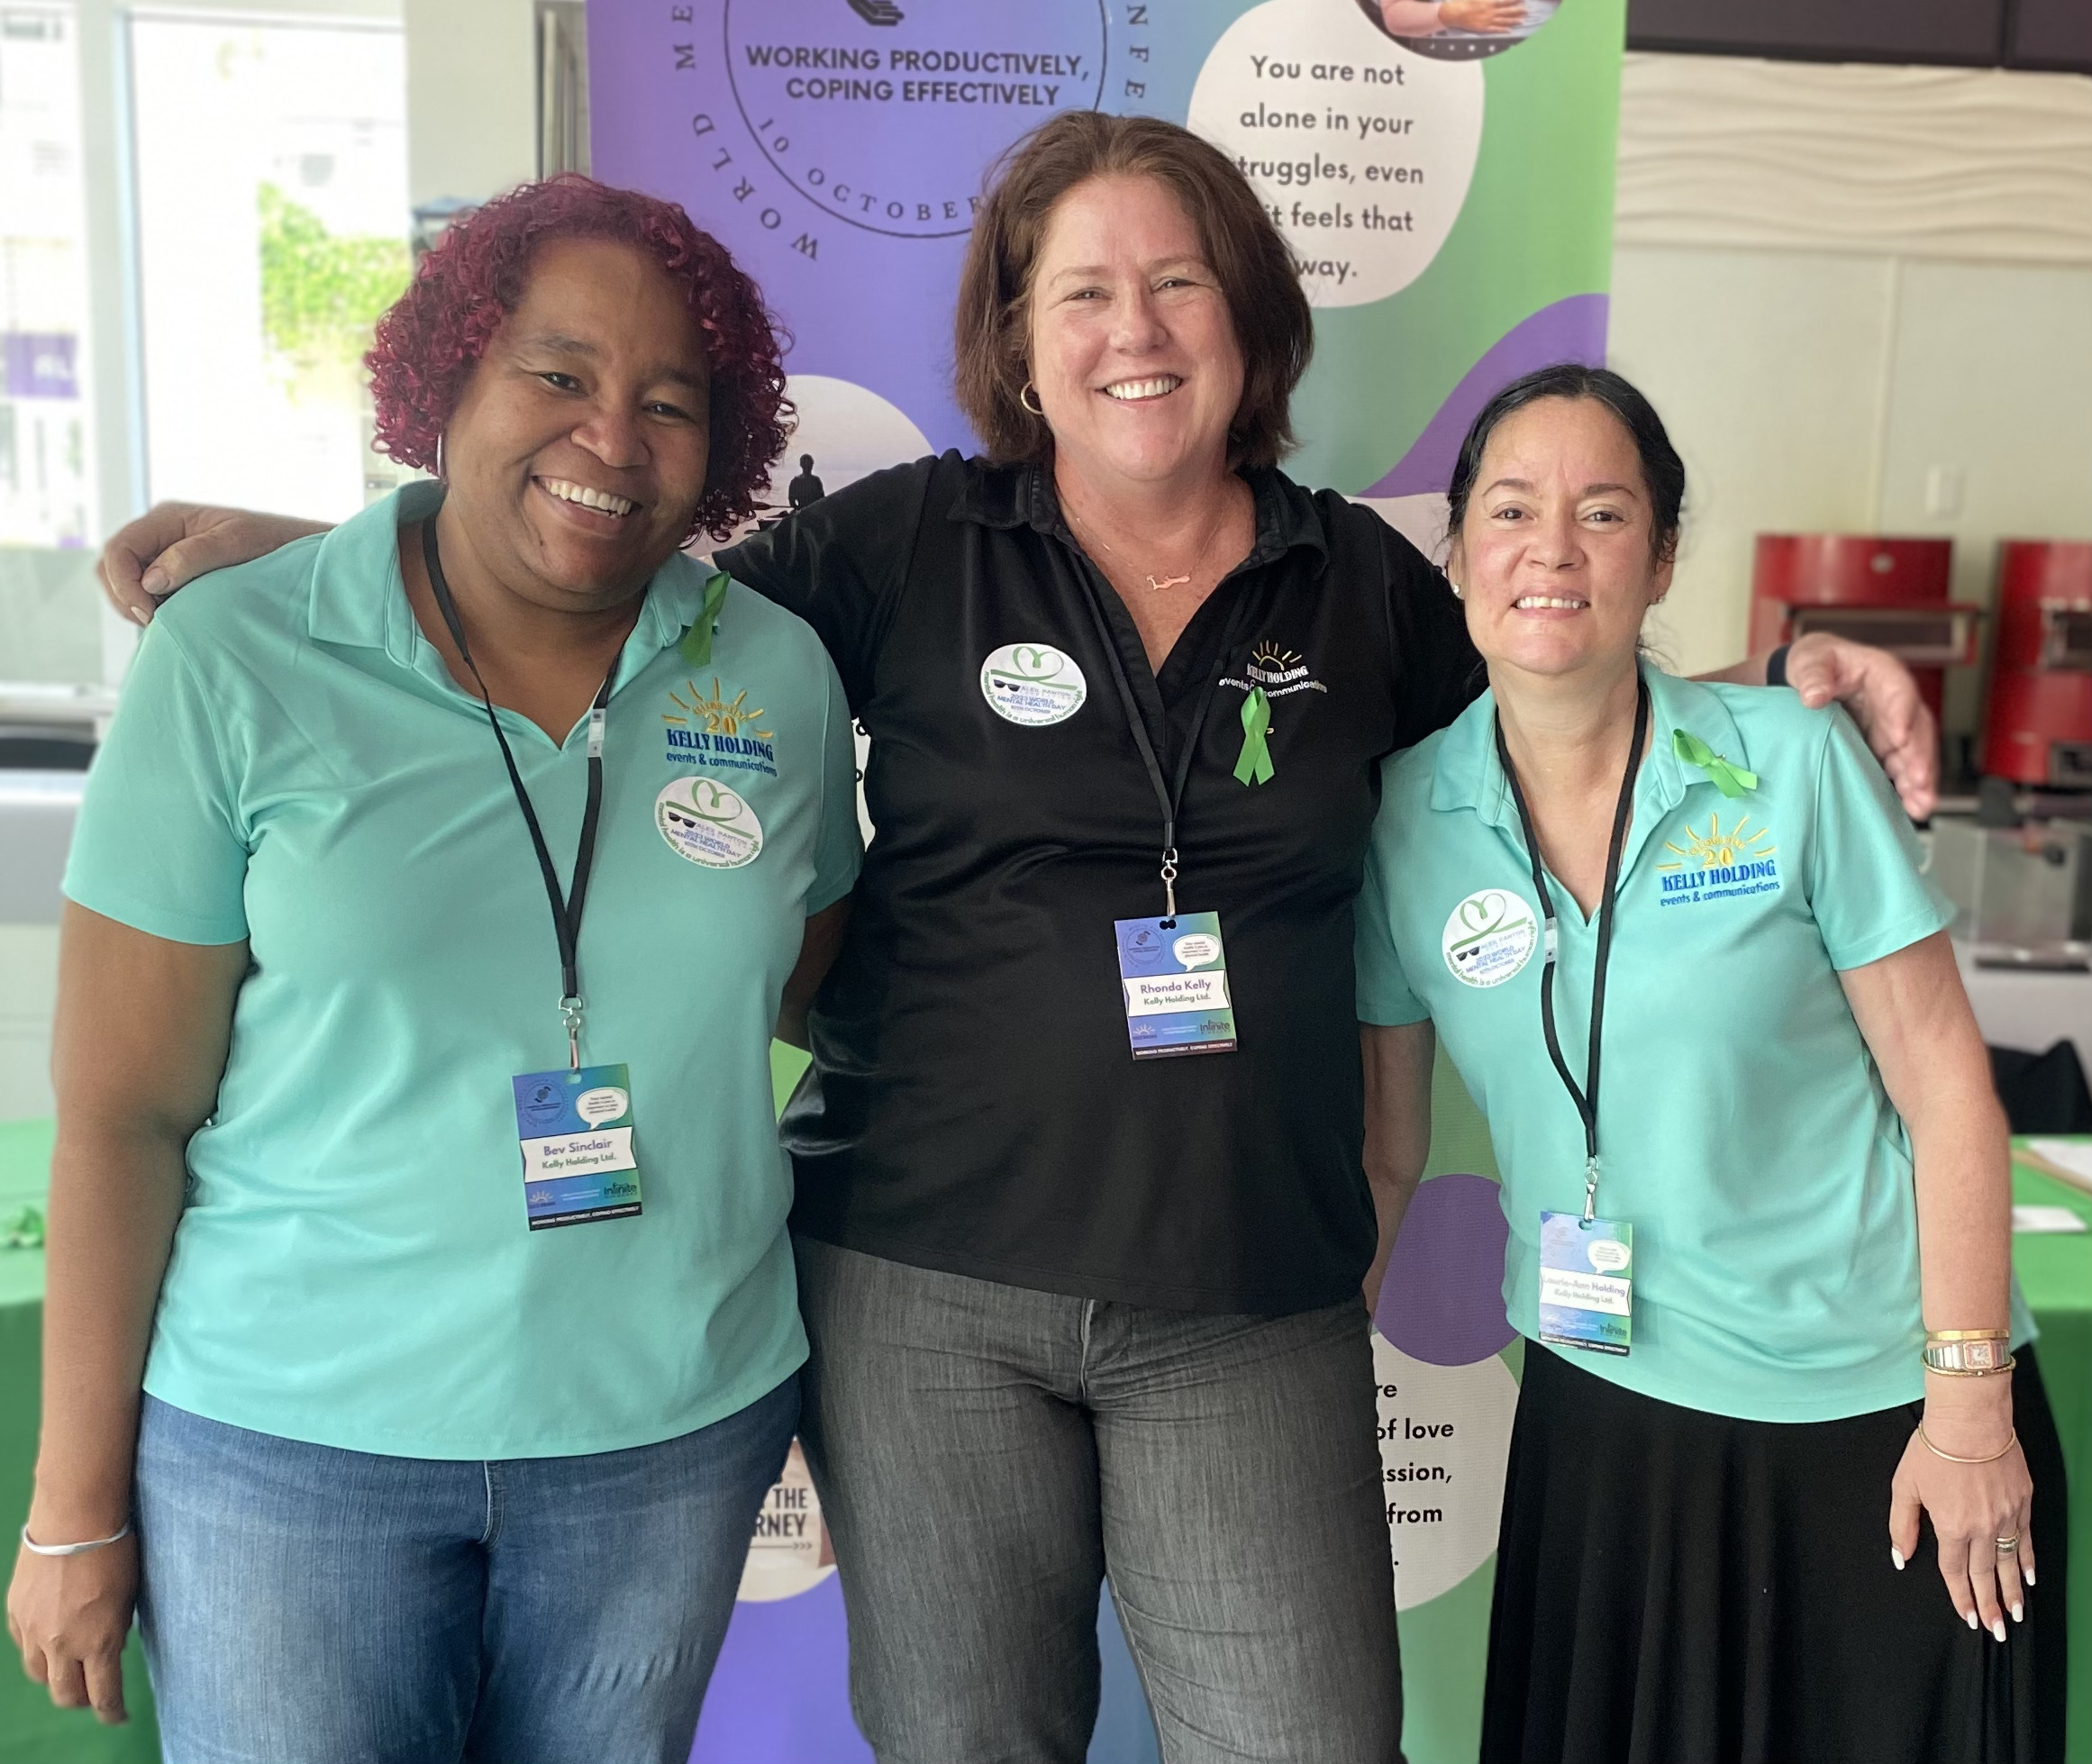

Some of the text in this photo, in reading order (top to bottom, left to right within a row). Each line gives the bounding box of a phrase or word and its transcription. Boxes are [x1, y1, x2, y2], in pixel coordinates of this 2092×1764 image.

[745, 45, 1089, 81] WORKING PRODUCTIVELY,
[1251, 55, 1405, 86] You are not
[786, 77, 1060, 105] COPING EFFECTIVELY
[1240, 102, 1414, 140] alone in your
[759, 118, 789, 152] 10
[1232, 153, 1423, 186] truggles, even
[692, 114, 818, 261] WORLD
[1291, 202, 1353, 228] feels
[1361, 205, 1414, 232] that
[1296, 260, 1358, 285] way.
[1267, 666, 1309, 683] HOLDING
[997, 696, 1023, 705] MENTAL
[1025, 701, 1051, 709] HEALTH
[706, 713, 737, 736] 20
[667, 729, 774, 761] KELLY HOLDING
[667, 753, 778, 777] events & communications
[670, 829, 741, 858] MENTAL HEALTH DAY
[1661, 859, 1777, 891] KELLY HOLDING
[1660, 882, 1780, 906] events & communications
[1140, 979, 1211, 994] Rhonda Kelly
[1143, 997, 1163, 1005] Kelly
[1165, 995, 1195, 1003] Holding
[544, 1139, 613, 1156] Bev Sinclair
[542, 1159, 564, 1169] Kelly
[566, 1156, 598, 1166] Holding
[1591, 1282, 1625, 1297] Holding
[1376, 1417, 1454, 1440] of love
[1380, 1462, 1452, 1484] ssion,
[772, 1487, 808, 1509] THE
[1387, 1502, 1442, 1524] from
